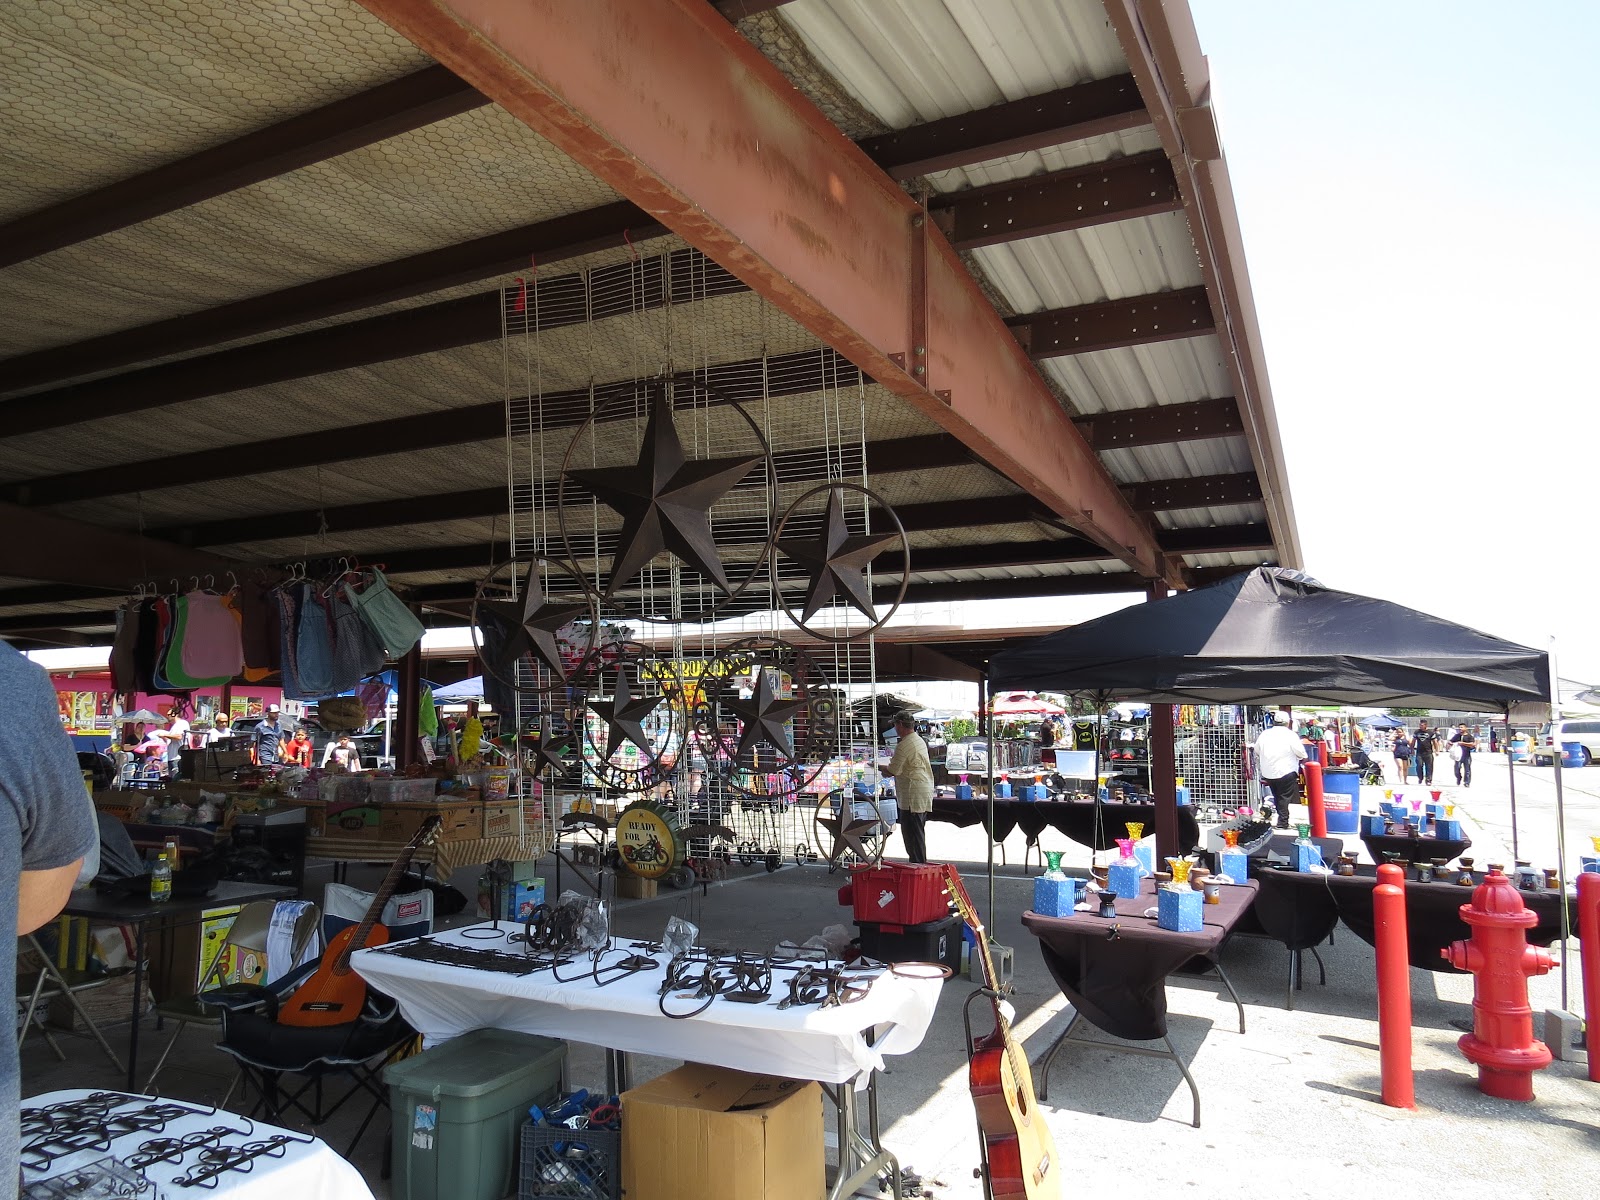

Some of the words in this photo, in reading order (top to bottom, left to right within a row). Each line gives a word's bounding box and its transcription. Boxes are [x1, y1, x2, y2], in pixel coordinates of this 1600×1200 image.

[610, 767, 653, 790] 1836
[628, 821, 657, 832] READY
[624, 832, 640, 841] FOR
[636, 863, 657, 871] DUTY
